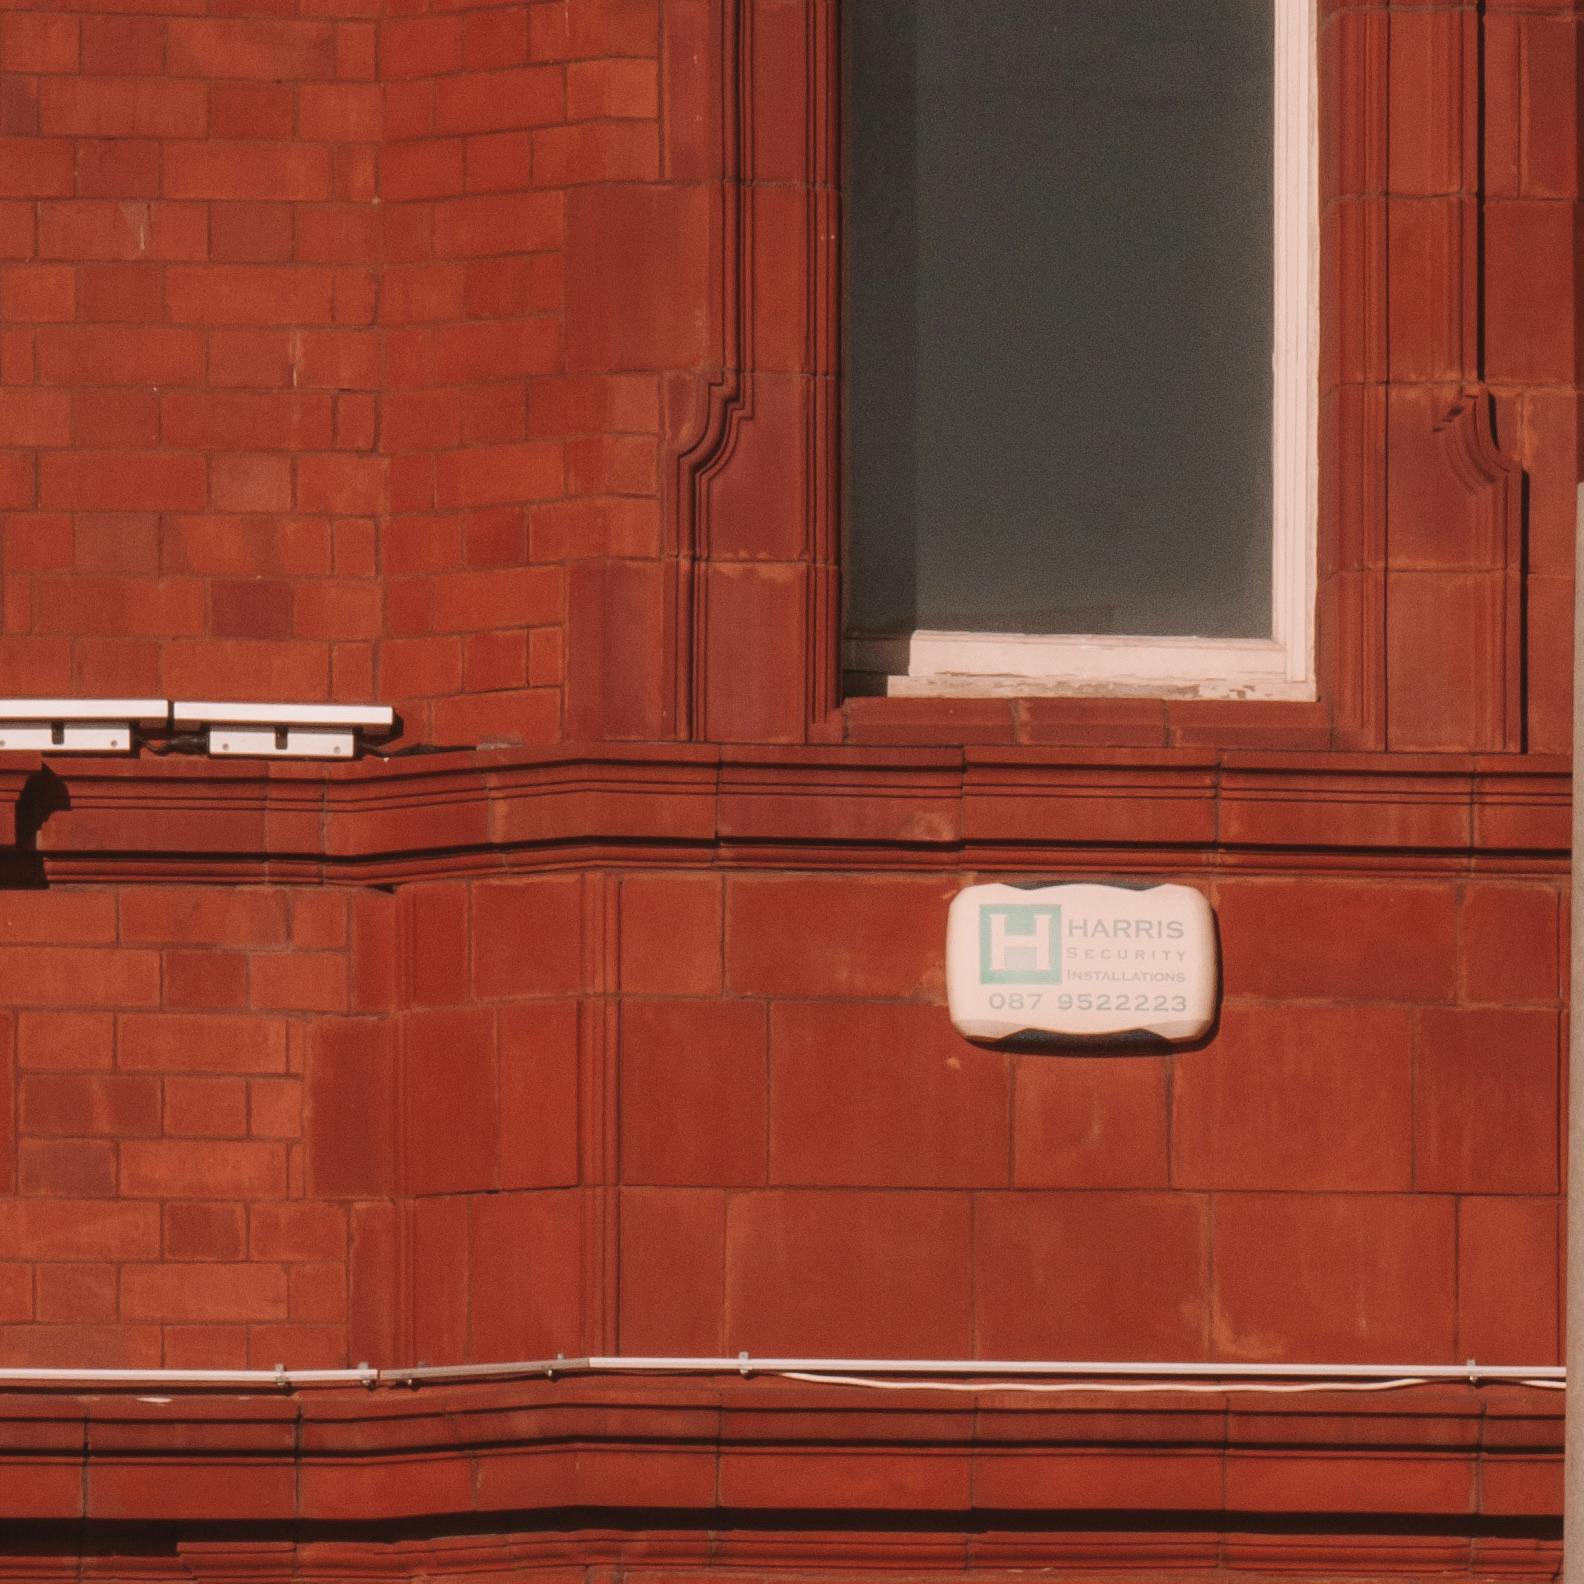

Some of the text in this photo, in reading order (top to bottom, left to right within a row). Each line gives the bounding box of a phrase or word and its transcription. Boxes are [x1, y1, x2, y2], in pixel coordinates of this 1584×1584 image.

[1067, 919, 1185, 939] HARRIS
[989, 913, 1052, 970] H
[989, 992, 1187, 1012] 087 9522223
